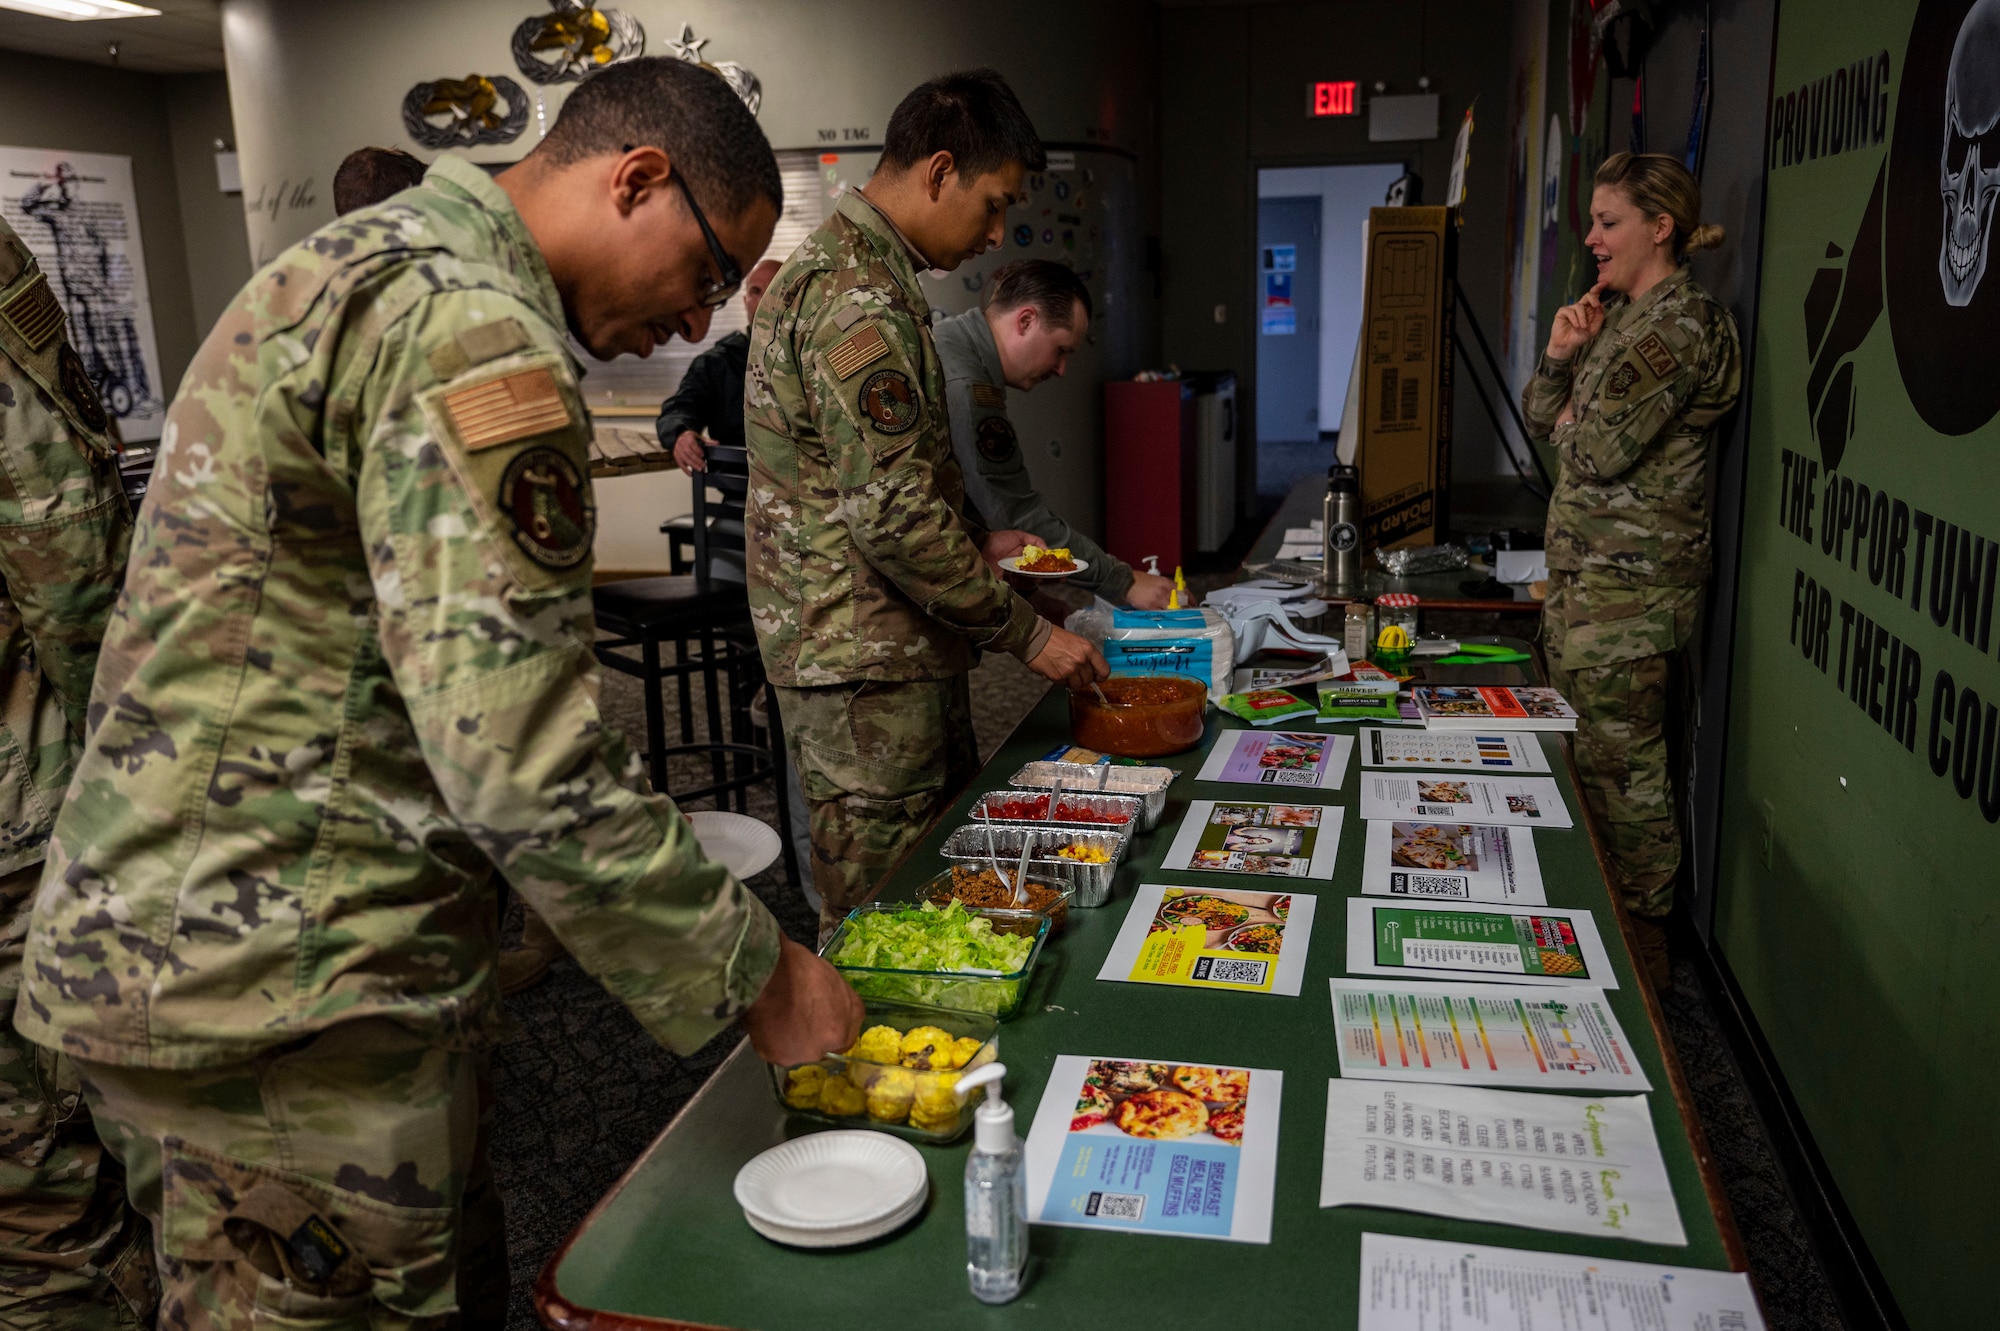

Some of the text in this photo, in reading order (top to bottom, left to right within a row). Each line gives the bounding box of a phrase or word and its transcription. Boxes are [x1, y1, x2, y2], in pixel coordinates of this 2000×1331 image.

[1314, 82, 1355, 116] EXIT
[1772, 49, 1889, 170] PROVIDING
[818, 128, 870, 142] NO TAG
[268, 179, 290, 222] of
[289, 178, 316, 210] the
[1443, 337, 1452, 369] BOARD
[1639, 338, 1673, 374] RTA
[1368, 492, 1405, 514] HEADER
[1380, 498, 1431, 532] BOARD
[1364, 523, 1378, 541] KI
[1779, 447, 2000, 661] THE OPPORTUNI
[1127, 654, 1190, 671] Napkins
[1790, 566, 1831, 675] FOR
[1837, 597, 1921, 754] THEIR
[1288, 829, 1298, 838] Meal
[1394, 875, 1405, 884] SCAN
[1521, 920, 1532, 941] DIRTY DOZEN
[1542, 926, 1554, 948] PESTICIDES
[1548, 920, 1567, 956] SHOPPER'S GUIDE
[1157, 938, 1178, 976] TURKEY TACO SALADS
[1173, 953, 1183, 963] MEAL
[1177, 941, 1186, 953] LUNCH
[1528, 947, 1537, 959] CLEAN
[1199, 960, 1210, 970] SCAN
[1365, 1104, 1377, 1132] ZUCCHINI
[1384, 1091, 1395, 1135] LEAFY GREENS
[1438, 1109, 1452, 1144] EGGPLANT
[1421, 1114, 1433, 1141] GRAPES
[1457, 1115, 1471, 1146] CHERRIES
[1476, 1124, 1489, 1148] CELERY
[1494, 1118, 1508, 1149] CARROTS
[1532, 1126, 1548, 1153] BERRIES
[1552, 1132, 1566, 1154] BEANS
[1571, 1133, 1586, 1156] APPLES
[1188, 1160, 1207, 1184] MEAL
[1364, 1144, 1377, 1182] POTATOES
[1383, 1146, 1396, 1182] PINEAPPLE
[1403, 1150, 1415, 1180] PEACHES
[1422, 1154, 1434, 1174] PEARS
[1441, 1157, 1454, 1184] ONIONS
[1460, 1158, 1474, 1186] MELONS
[1480, 1160, 1492, 1177] KIWI
[1499, 1162, 1514, 1188] GARLIC
[1519, 1164, 1534, 1190] CITRUS
[1162, 1154, 1189, 1216] EGG MUFFINS
[1202, 1161, 1226, 1216] BREAKFAST
[1539, 1165, 1555, 1200] BANANAS
[1560, 1168, 1577, 1205] APRICOTS
[1580, 1170, 1599, 1216] AVOCADOS
[1599, 1169, 1630, 1229] Room Temp
[1718, 1308, 1746, 1331] FUE
